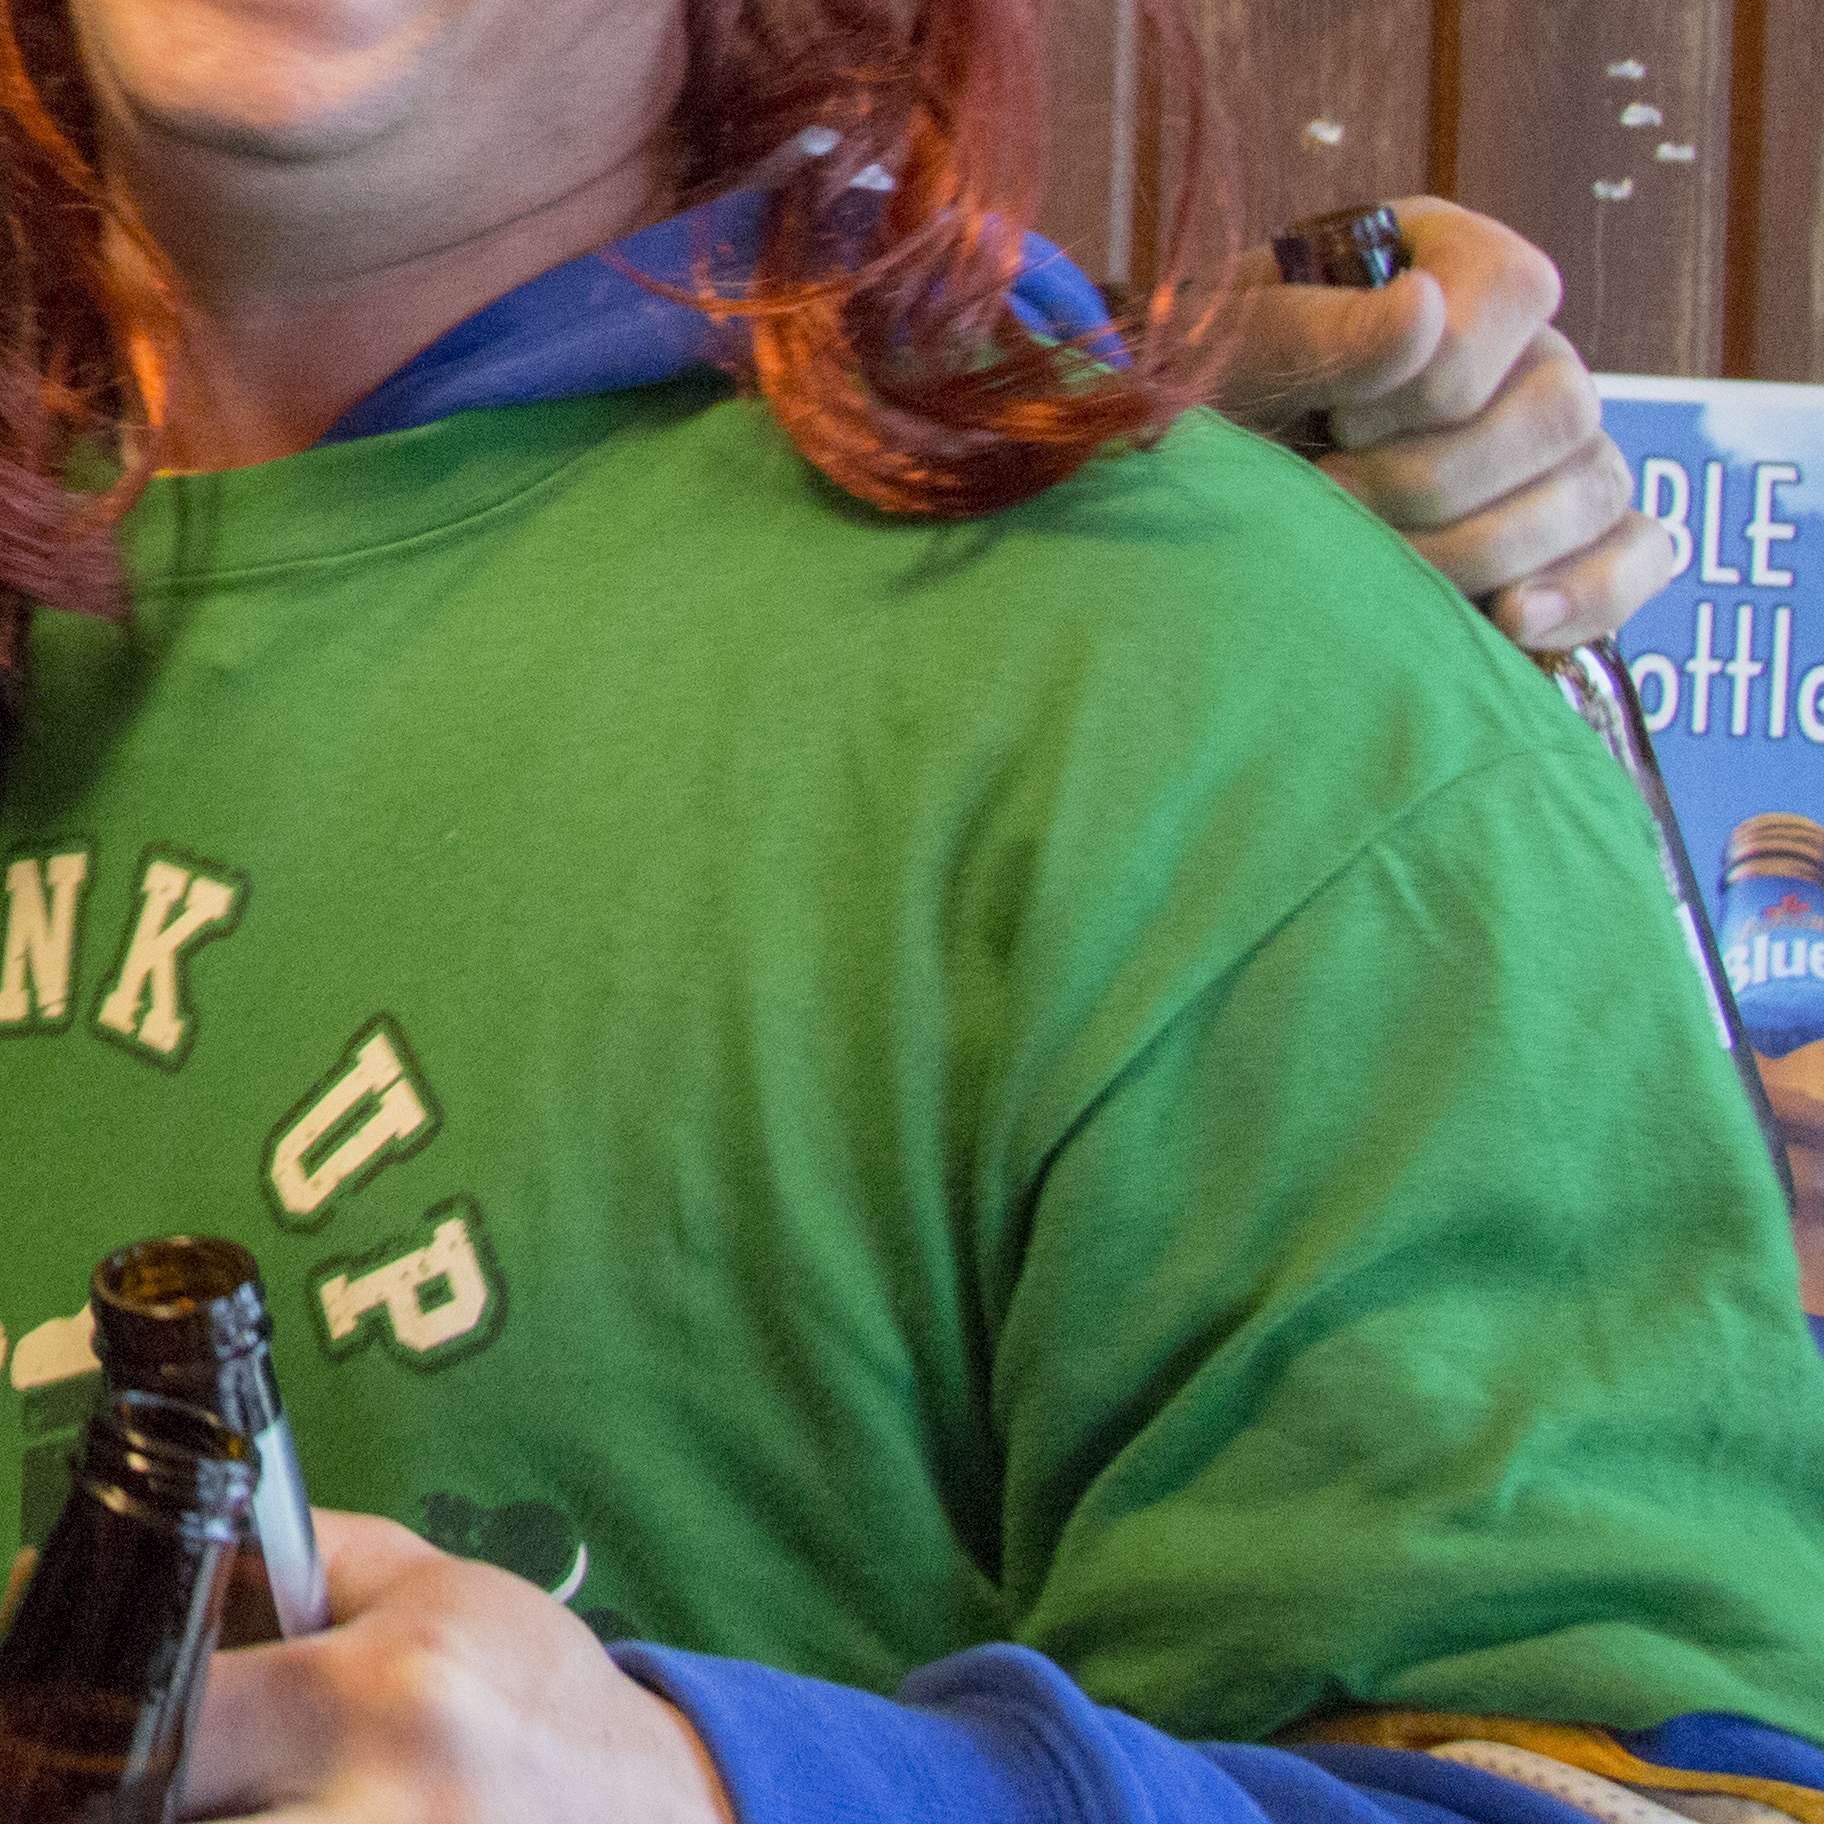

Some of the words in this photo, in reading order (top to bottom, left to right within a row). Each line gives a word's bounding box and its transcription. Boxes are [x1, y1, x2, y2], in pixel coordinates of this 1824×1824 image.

[1640, 457, 1801, 588] BLE
[1631, 603, 1824, 744] ottle
[262, 1011, 508, 1376] UP
